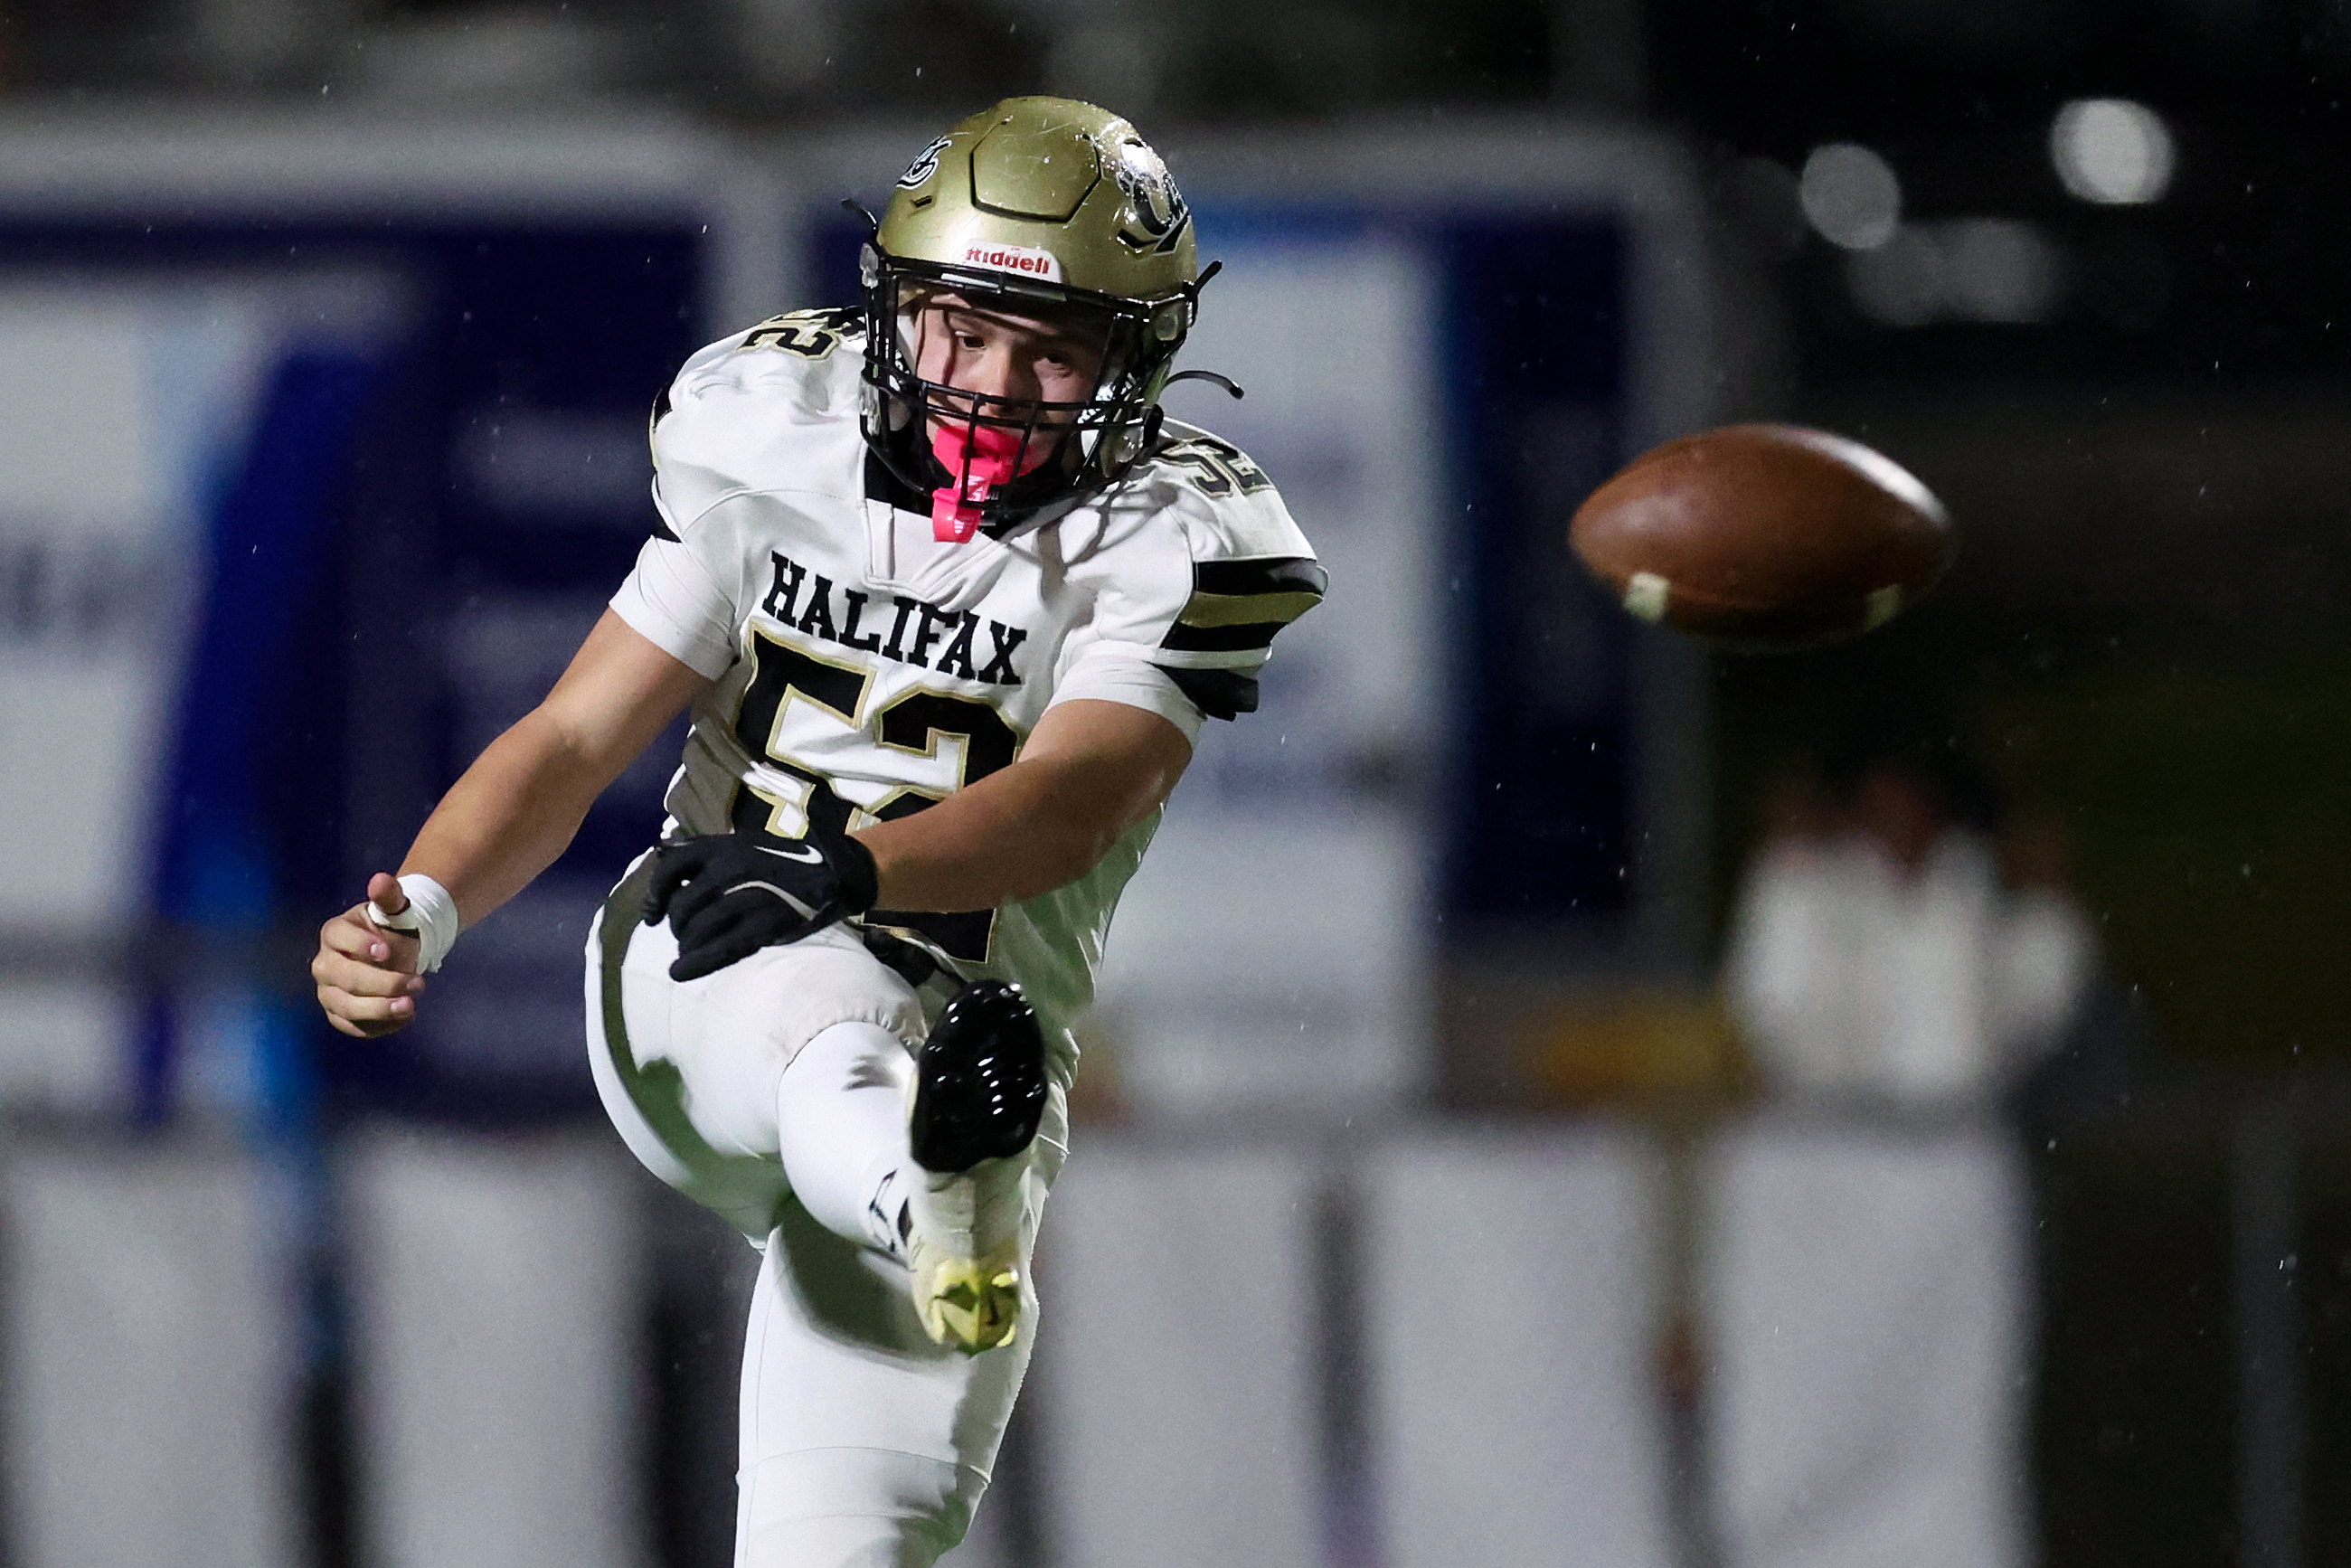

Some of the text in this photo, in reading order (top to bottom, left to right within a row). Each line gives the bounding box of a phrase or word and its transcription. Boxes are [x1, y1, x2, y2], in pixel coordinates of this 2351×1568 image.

[966, 246, 1051, 274] Riddell
[761, 550, 1028, 685] HALIFAX
[729, 617, 1019, 964] 52
